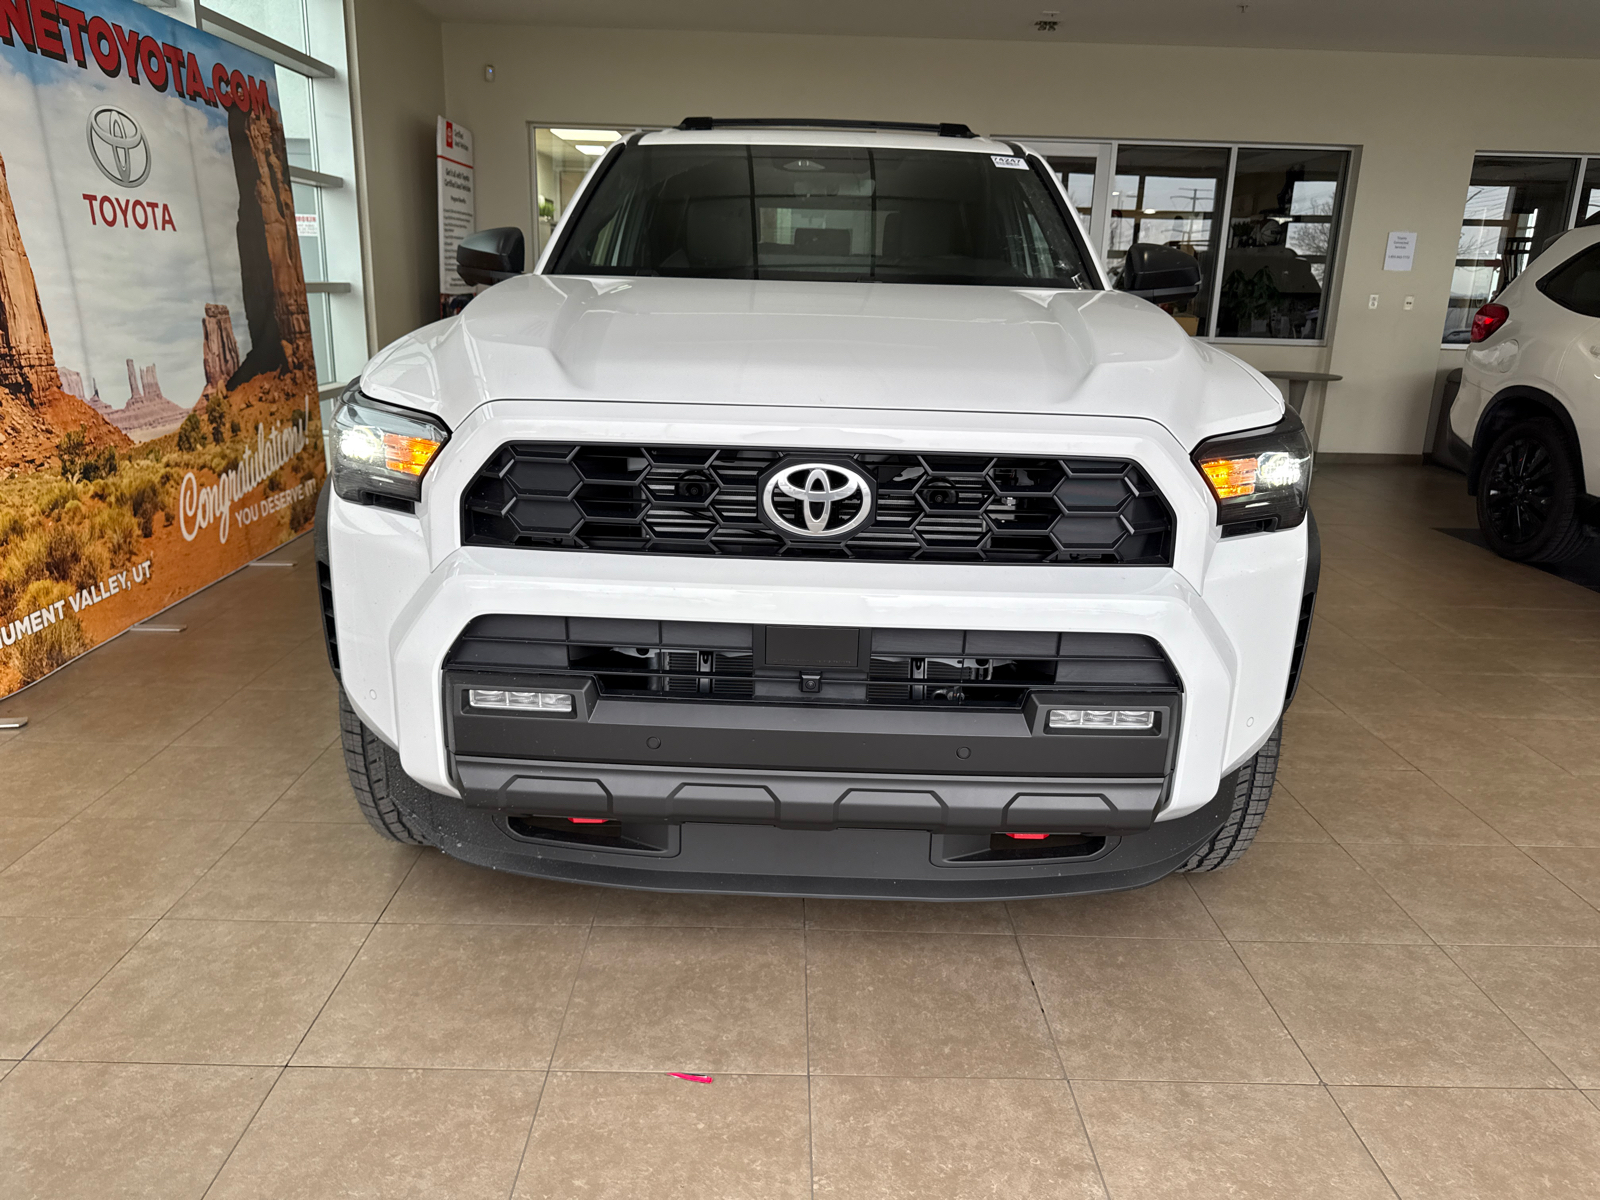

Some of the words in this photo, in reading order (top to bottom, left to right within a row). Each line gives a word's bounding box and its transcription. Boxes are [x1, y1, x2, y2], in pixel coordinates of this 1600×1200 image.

[82, 193, 177, 232] TOYOTA
[235, 503, 259, 528] YOU
[260, 484, 304, 517] DESERVE
[304, 478, 317, 497] IT!
[68, 570, 132, 613] VALLEY,
[132, 560, 151, 583] UT
